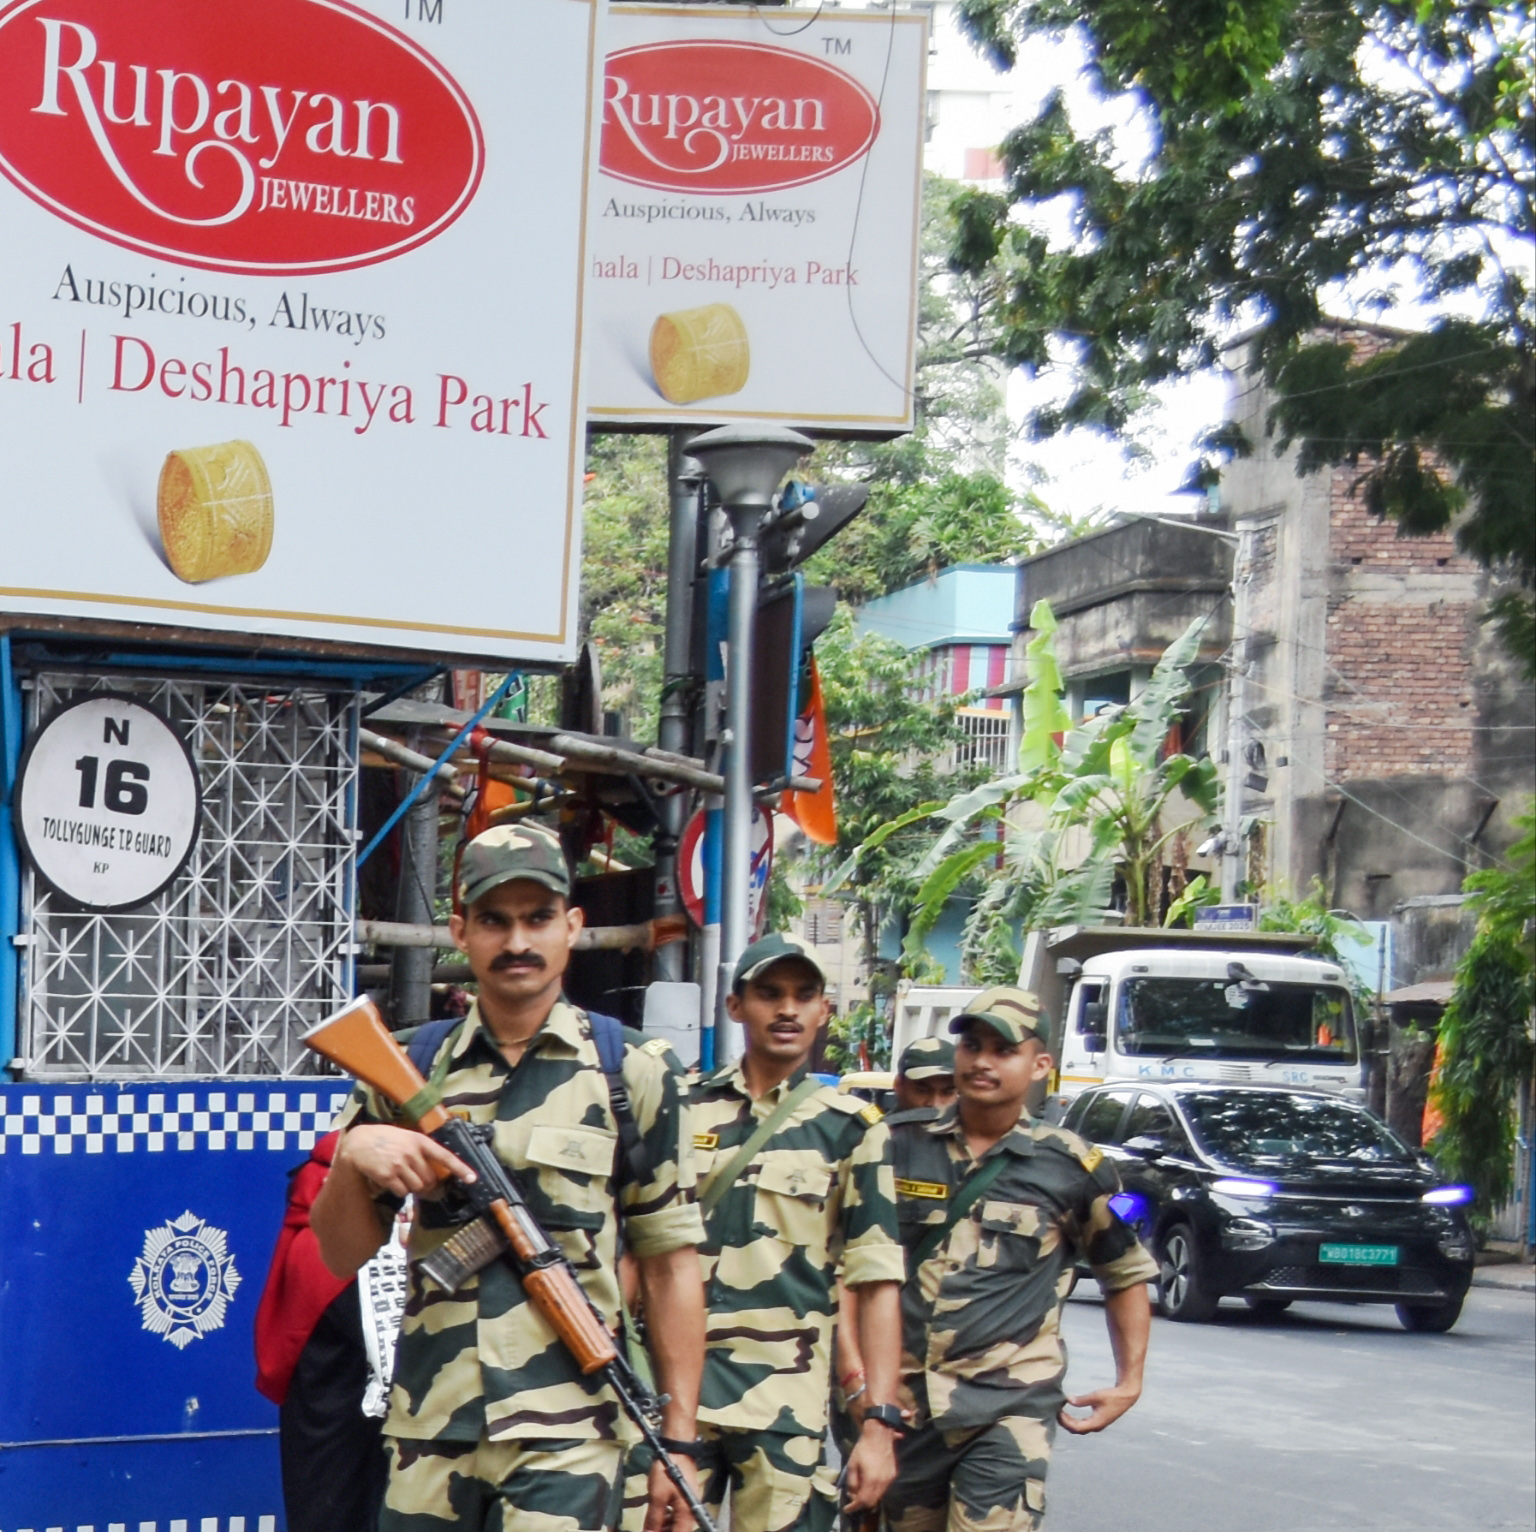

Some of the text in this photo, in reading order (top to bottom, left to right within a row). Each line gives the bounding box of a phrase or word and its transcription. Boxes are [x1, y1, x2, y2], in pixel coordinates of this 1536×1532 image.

[822, 38, 851, 55] TM
[31, 16, 406, 227] Rupayan
[602, 75, 826, 172] Rupayan
[731, 144, 834, 162] JEWELLERS
[258, 176, 416, 227] JEWELLERS
[602, 197, 816, 227] Auspicious, Always
[592, 255, 859, 289] hala Deshapriya Park
[51, 263, 387, 345] Auspicious, Always
[108, 334, 416, 435] Deshapriya
[434, 374, 552, 440] Park
[103, 717, 130, 747] N
[75, 755, 151, 816] 16
[43, 817, 116, 850] TOLLYGUNGE
[135, 831, 172, 858] GUARD
[93, 861, 110, 874] KP
